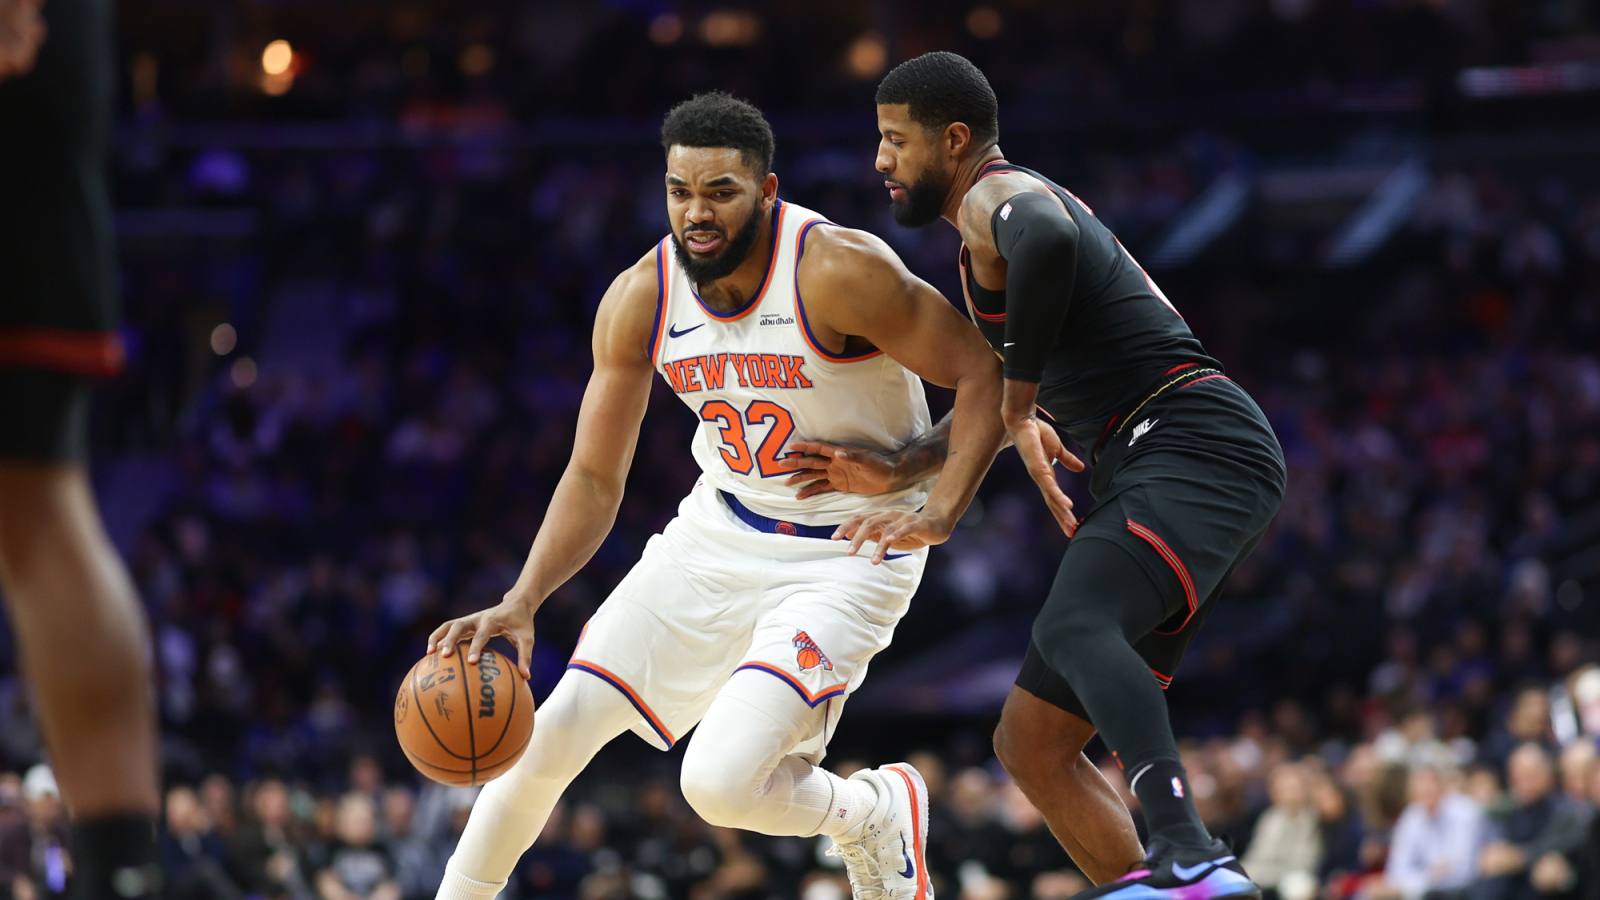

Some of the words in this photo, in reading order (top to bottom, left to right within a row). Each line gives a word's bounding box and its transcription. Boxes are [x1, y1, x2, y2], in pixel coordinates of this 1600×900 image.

[760, 318, 775, 326] abu
[776, 316, 794, 325] dhabi
[664, 353, 728, 393] NEW
[730, 353, 813, 388] YORK
[699, 399, 806, 478] 32
